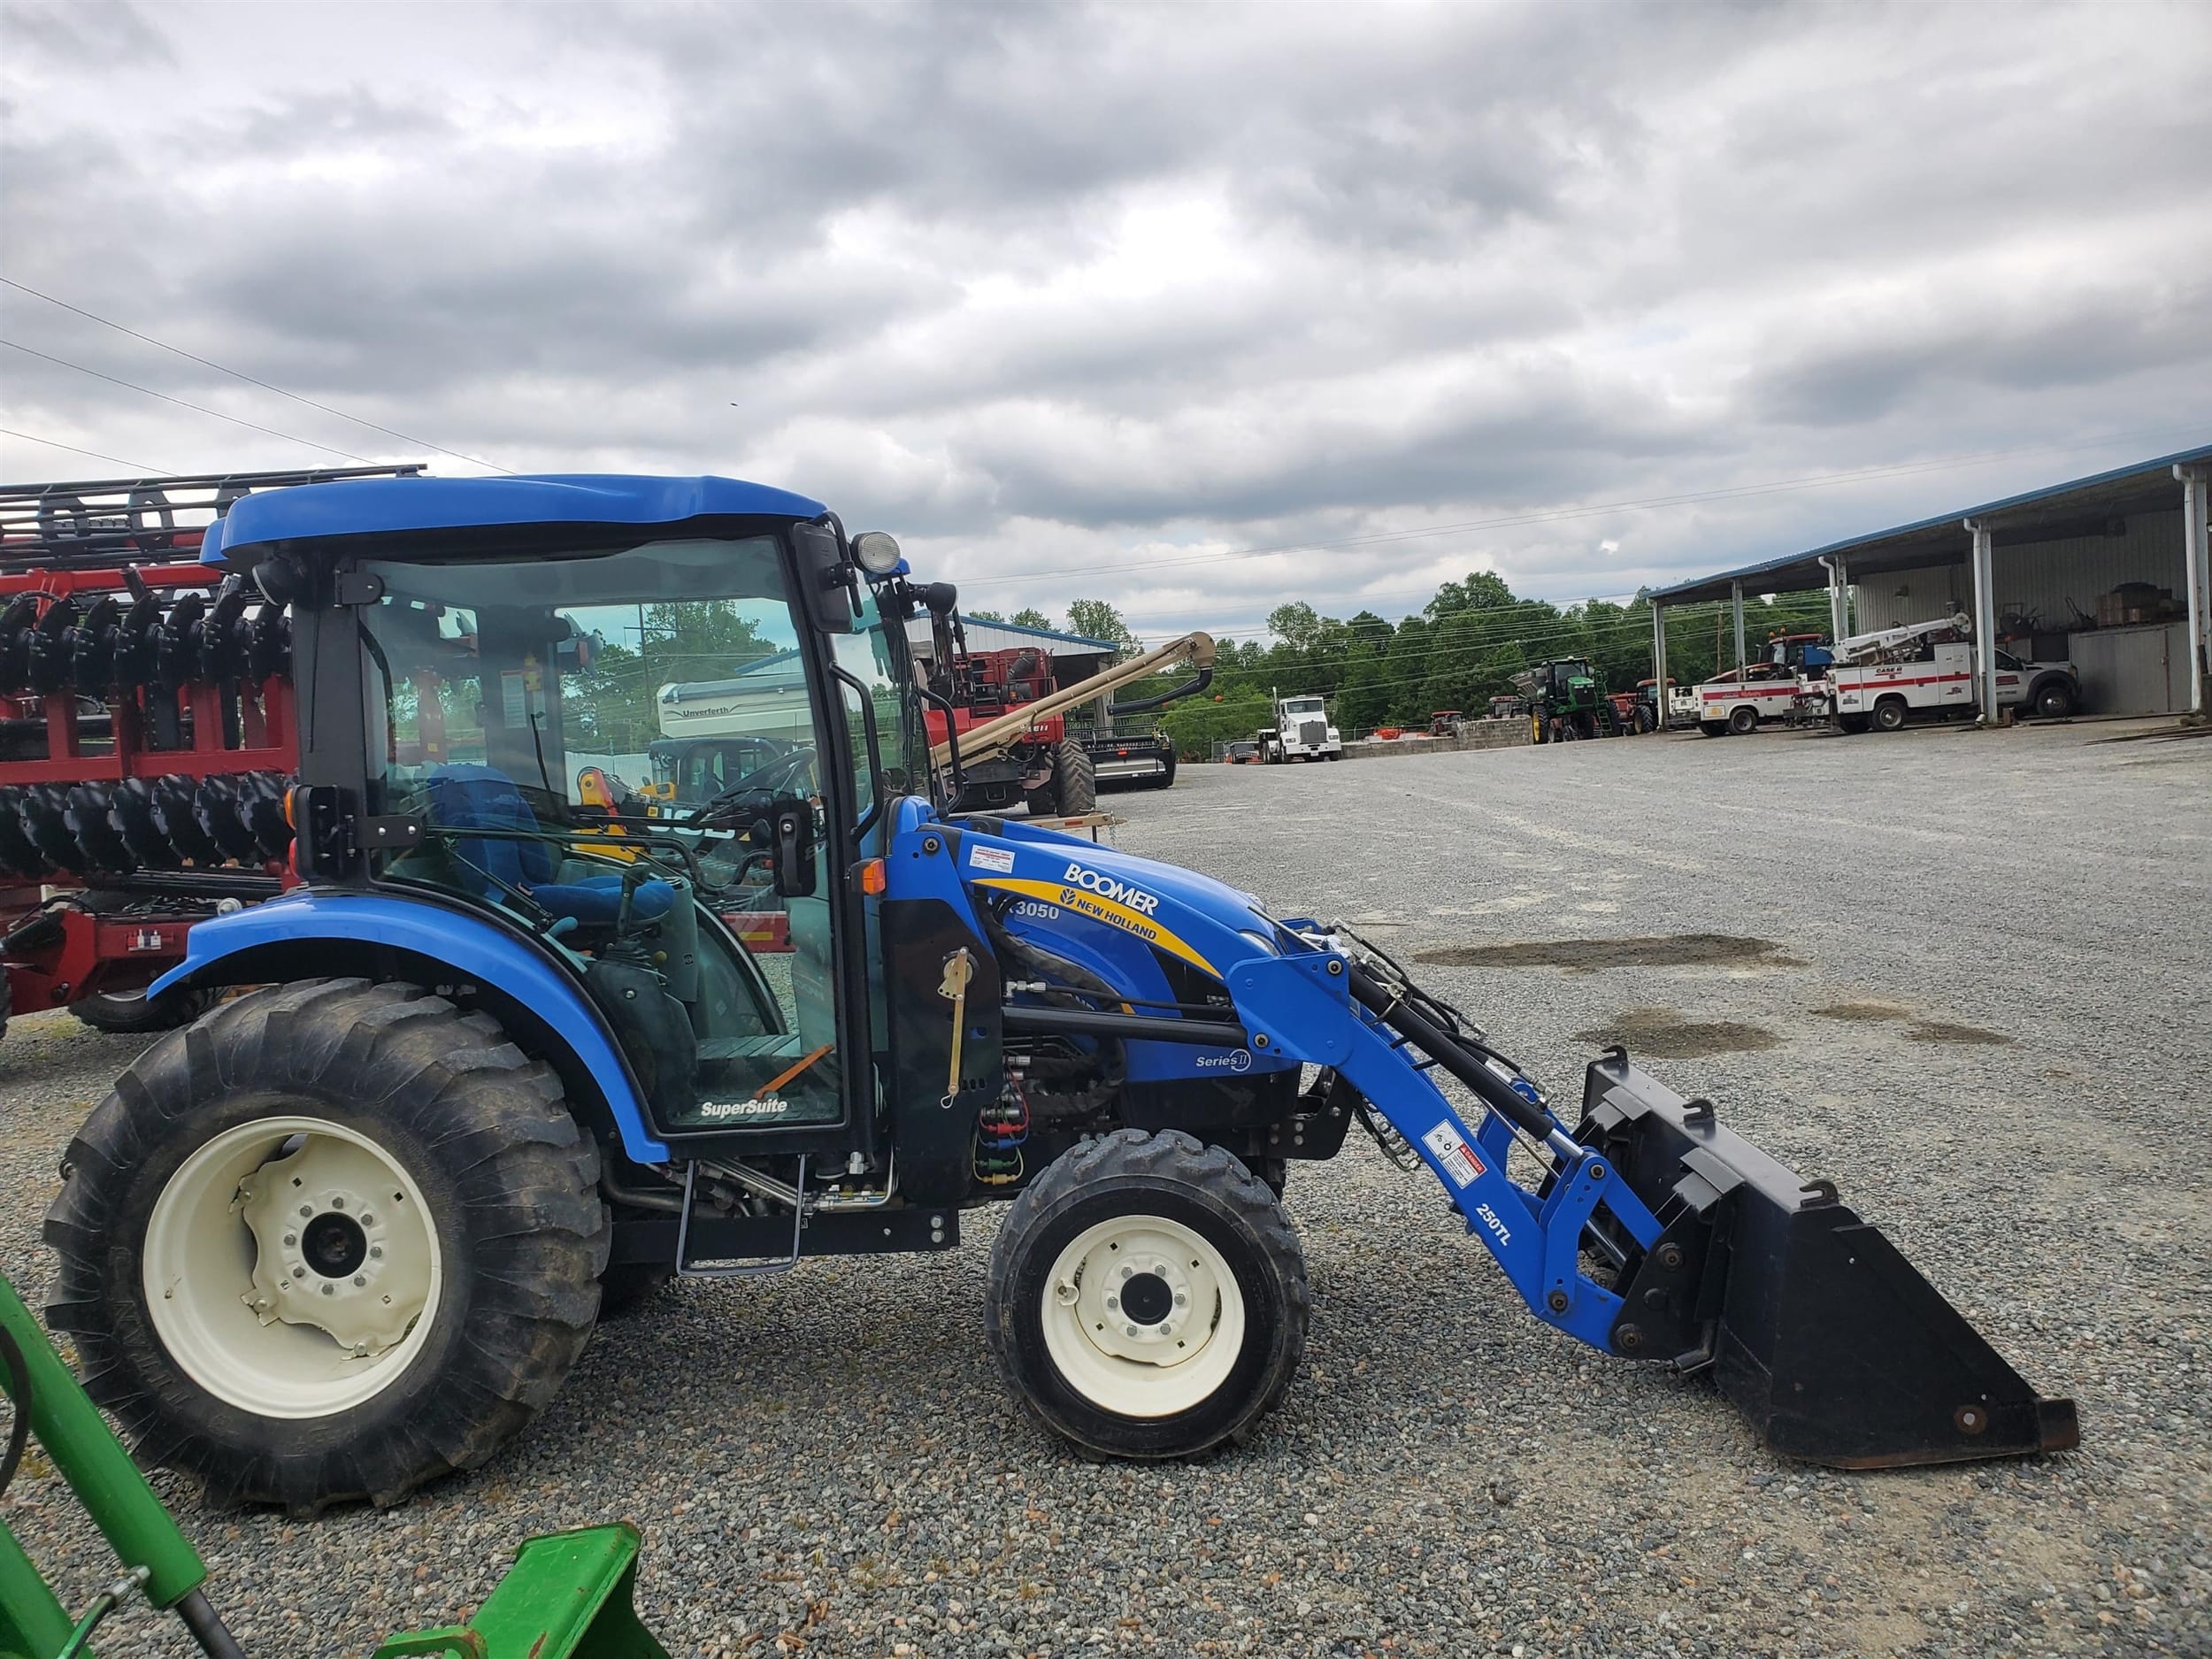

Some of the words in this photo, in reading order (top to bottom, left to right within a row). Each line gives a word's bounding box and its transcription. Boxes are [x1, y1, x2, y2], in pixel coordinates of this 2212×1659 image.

[682, 707, 729, 717] Unverferth
[1064, 863, 1159, 916] BOOMER
[1016, 901, 1060, 920] 3050
[1077, 899, 1103, 917] NEW
[1104, 911, 1156, 940] HOLLAND
[1195, 1056, 1238, 1067] Series
[701, 1098, 787, 1118] SuperSuite
[1475, 1203, 1511, 1246] 250TL
[108, 1298, 196, 1412] TITAN
